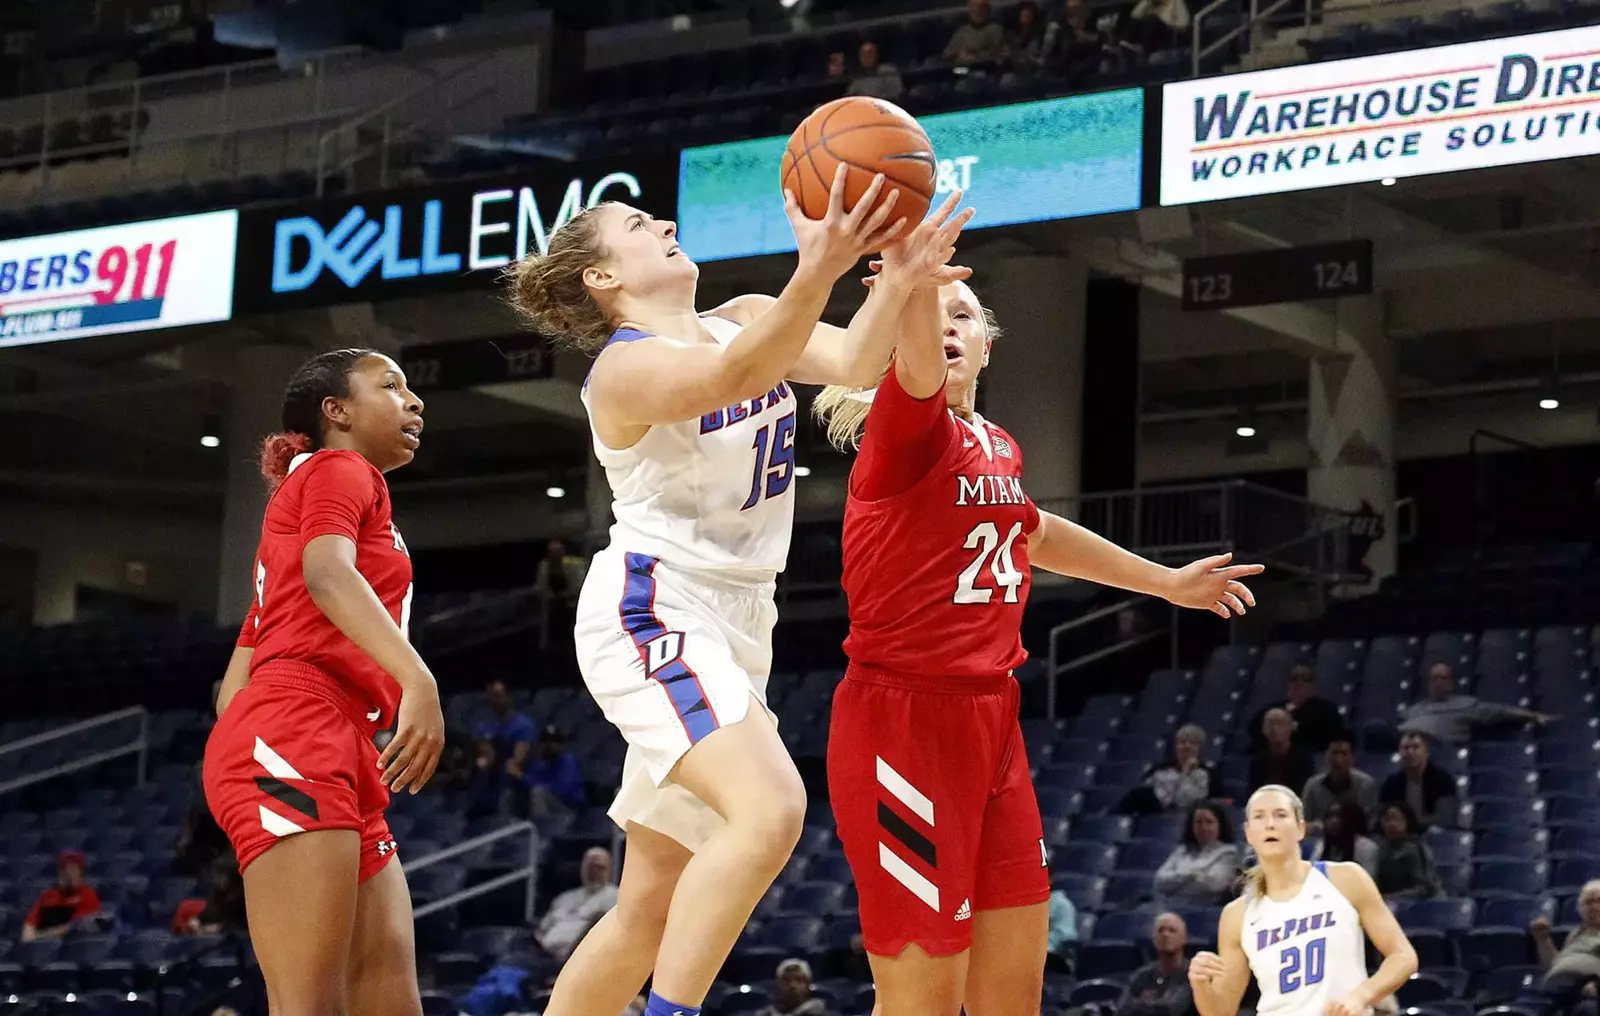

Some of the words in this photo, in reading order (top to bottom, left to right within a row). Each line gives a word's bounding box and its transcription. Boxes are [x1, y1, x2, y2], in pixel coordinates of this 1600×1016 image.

[1192, 77, 1480, 144] WAREHOUSE
[1191, 131, 1423, 182] WORKPLACE
[1445, 110, 1600, 151] SOLUTI
[271, 200, 461, 293] DELL
[1188, 273, 1233, 303] 123
[1313, 260, 1359, 290] 124
[740, 411, 795, 511] 15
[953, 521, 1024, 604] 24
[1257, 911, 1336, 951] DEPAUL
[1280, 936, 1326, 995] 20
